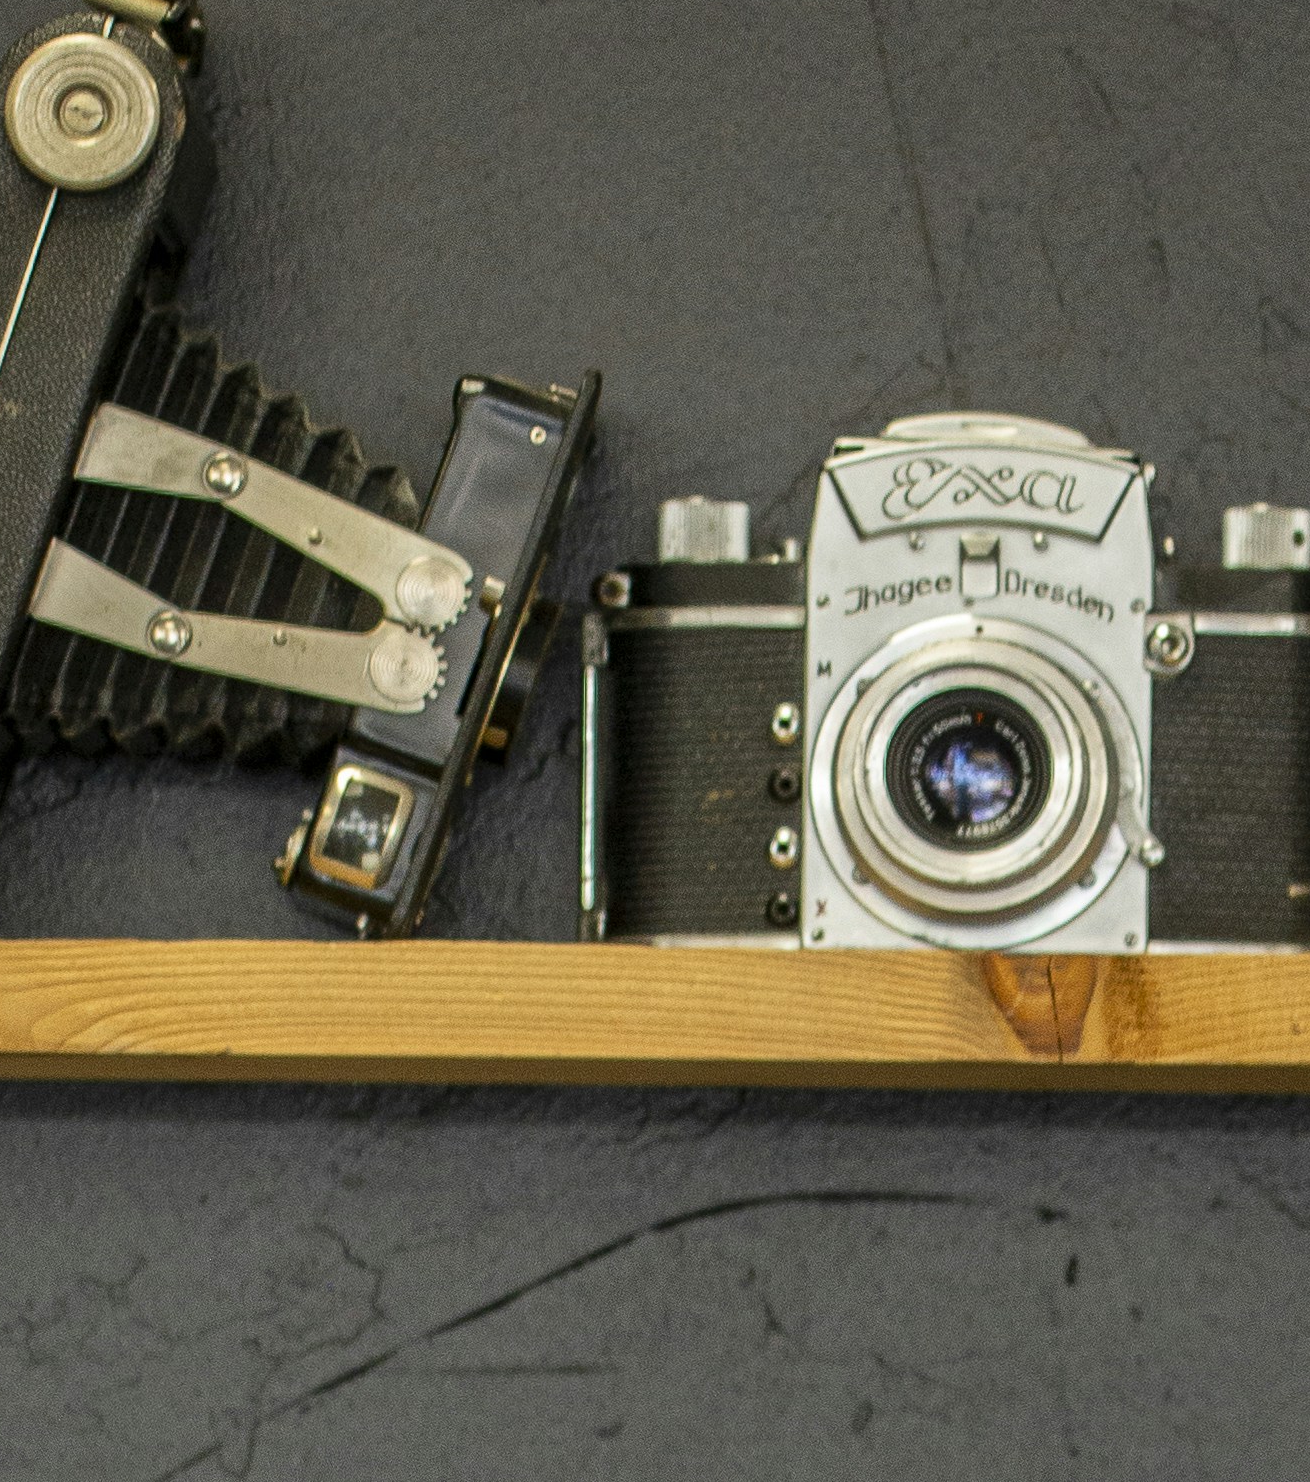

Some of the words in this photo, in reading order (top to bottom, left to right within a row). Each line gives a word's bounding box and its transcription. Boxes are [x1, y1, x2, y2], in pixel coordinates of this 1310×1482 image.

[881, 458, 1084, 520] Exa
[1003, 567, 1115, 623] Dresden
[817, 660, 832, 678] M
